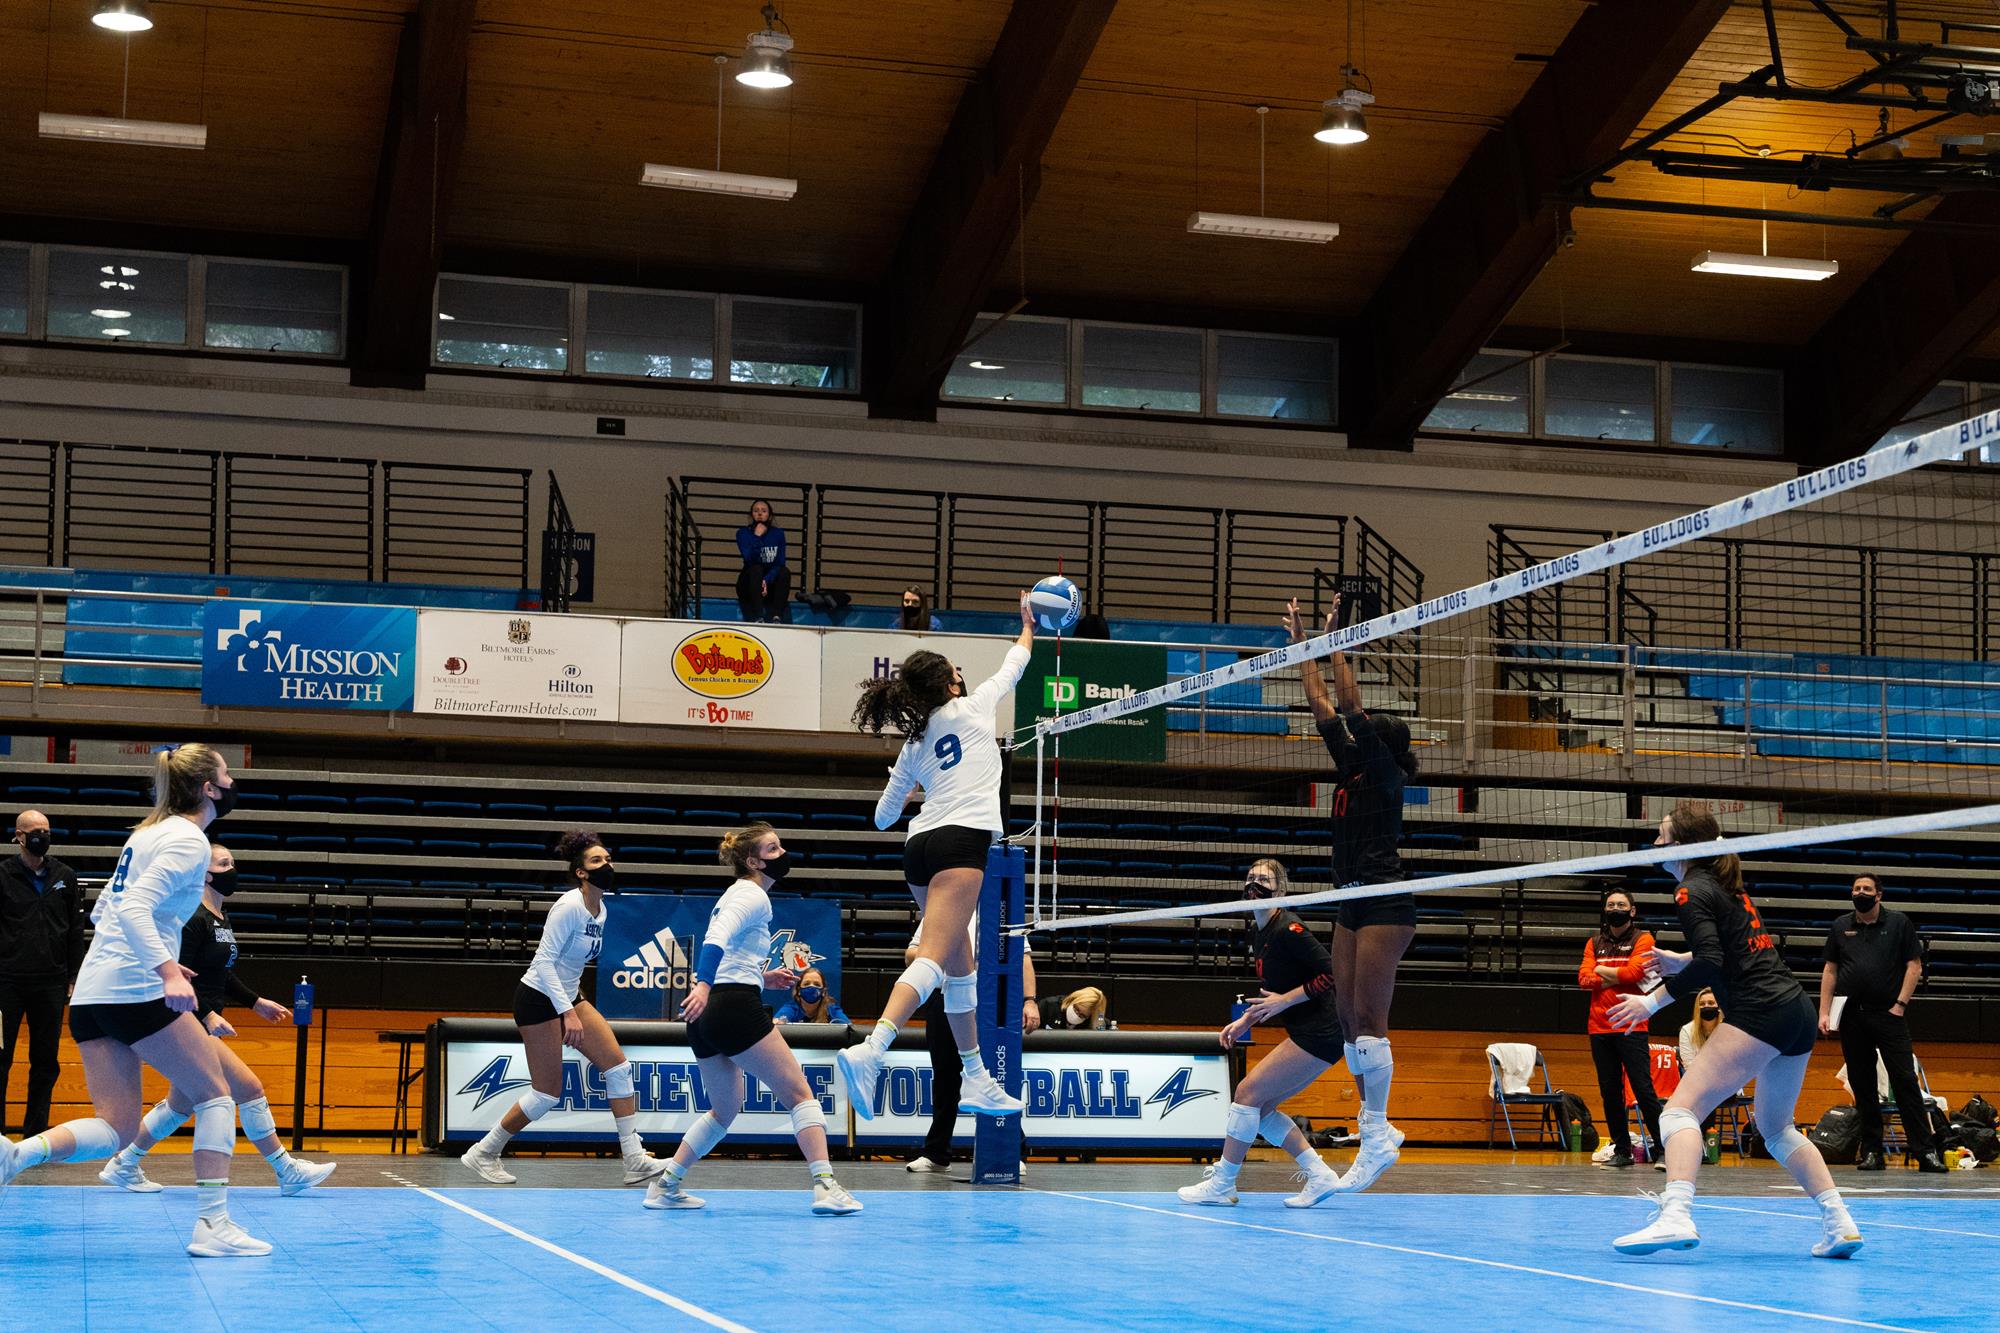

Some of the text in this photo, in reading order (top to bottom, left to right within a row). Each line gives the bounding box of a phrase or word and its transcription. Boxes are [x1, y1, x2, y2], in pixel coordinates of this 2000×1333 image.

[1180, 672, 1214, 694] BULLDOGS
[1250, 649, 1287, 672] BULLDOGS
[1328, 622, 1370, 648] BULLDOGS
[1417, 591, 1467, 620] BULLDOGS
[1521, 554, 1580, 587] BULLDOGS
[1643, 511, 1710, 548] BULLDOGS
[1787, 458, 1868, 502] BULLDOGS
[1066, 592, 1078, 621] molten
[264, 643, 400, 677] MISSION
[481, 644, 523, 654] BILTMORE
[280, 677, 383, 702] HEALTH
[549, 680, 593, 693] Hilton
[1047, 681, 1137, 702] TD Bank
[434, 697, 597, 717] BiltmoreFarmsHotels.com
[688, 701, 754, 723] IT'S BO TIME!
[934, 733, 963, 771] 9
[112, 846, 133, 892] 8
[996, 1045, 1006, 1084] sports
[1657, 1054, 1672, 1069] 15
[1707, 1137, 1716, 1147] G
